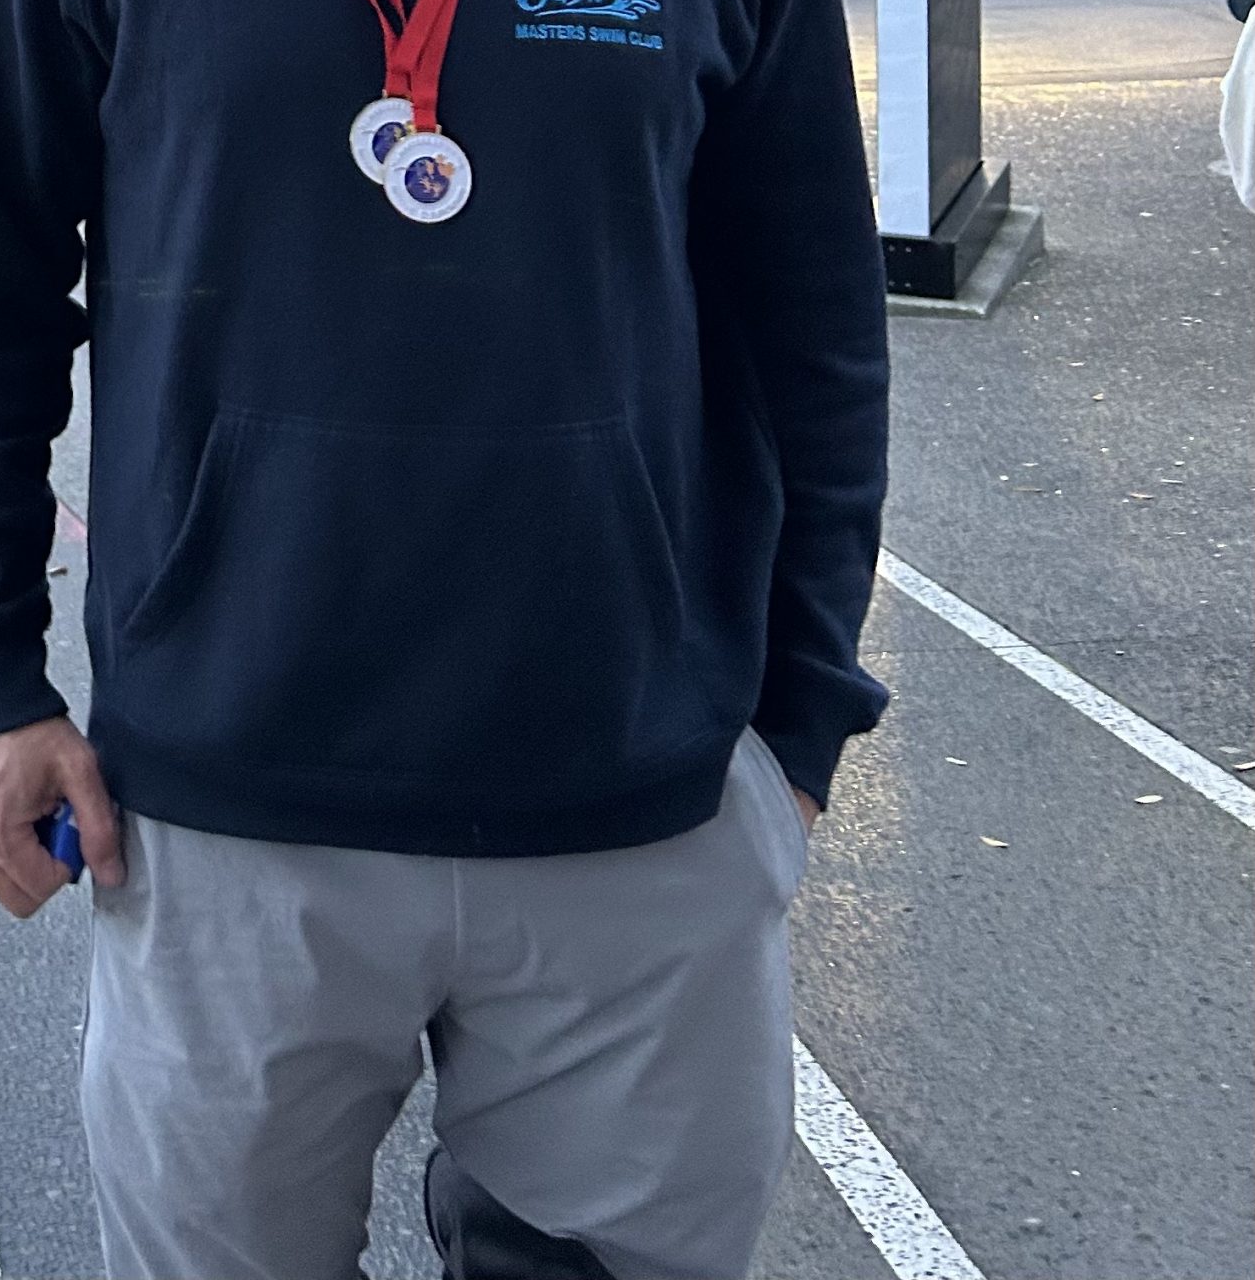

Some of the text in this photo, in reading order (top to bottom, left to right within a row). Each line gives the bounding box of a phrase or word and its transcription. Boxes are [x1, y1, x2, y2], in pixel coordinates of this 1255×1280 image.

[515, 24, 664, 50] MASTERS SWIM CLUB
